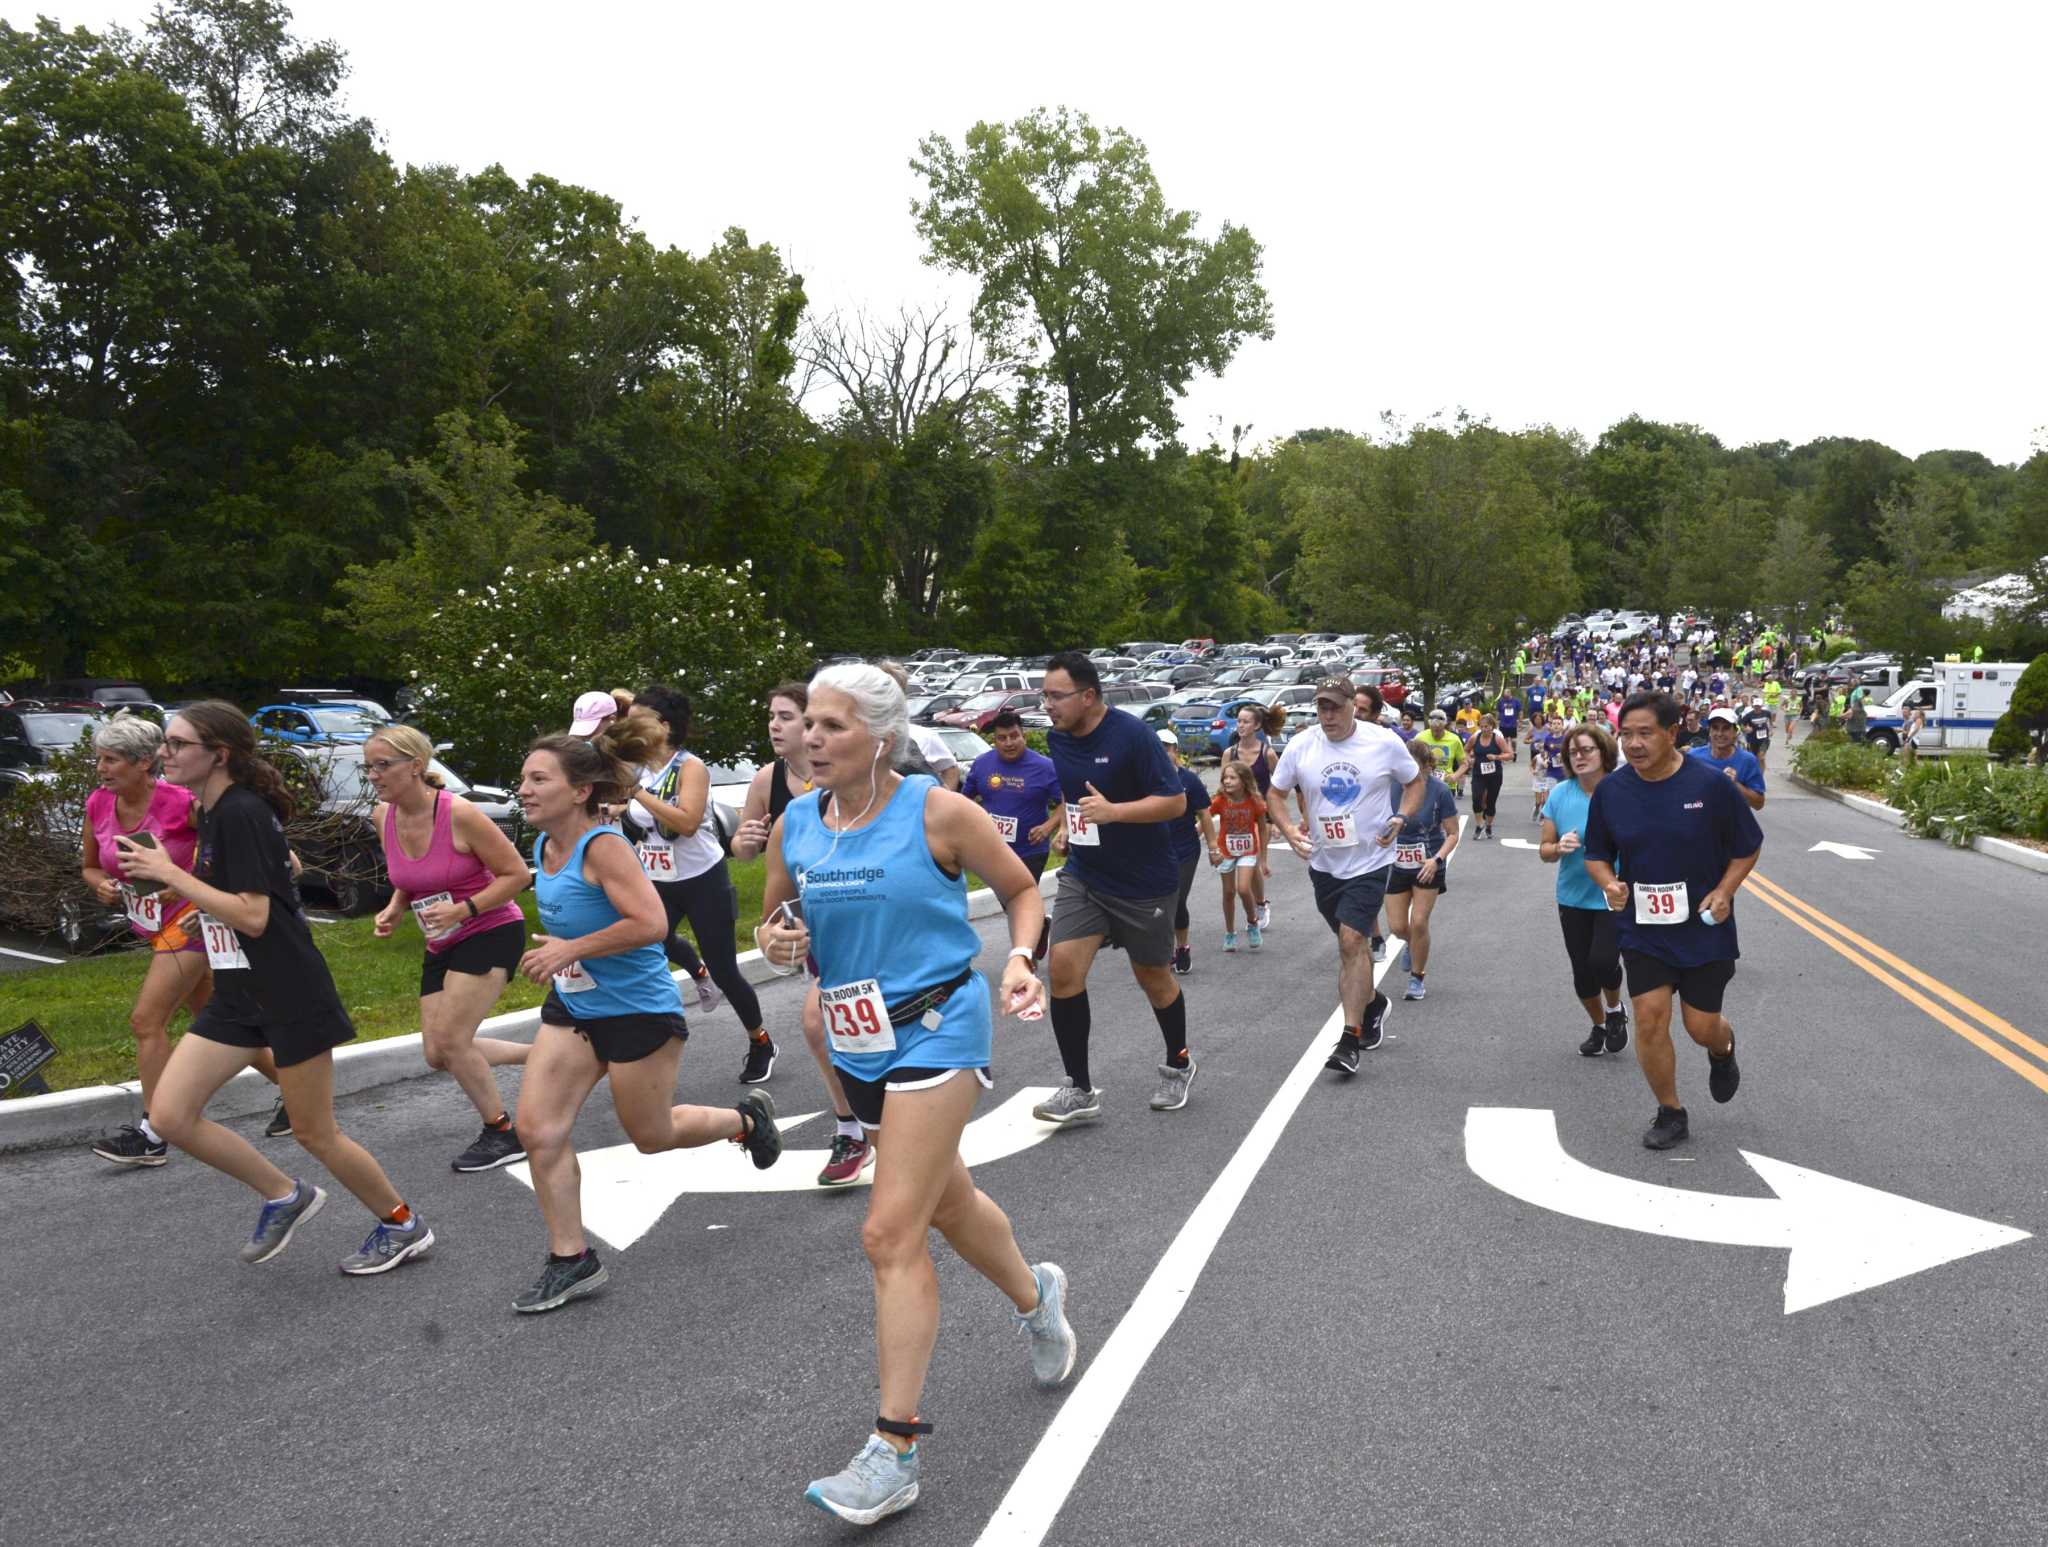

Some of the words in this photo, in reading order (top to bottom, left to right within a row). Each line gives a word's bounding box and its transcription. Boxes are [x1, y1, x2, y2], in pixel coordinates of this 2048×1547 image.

[995, 821, 1013, 836] 82
[1070, 815, 1087, 834] 54
[1324, 822, 1345, 839] 56
[1230, 839, 1250, 851] 160
[1396, 849, 1422, 863] 256
[806, 867, 886, 883] Southridge
[1658, 885, 1674, 893] ROOM
[1647, 894, 1675, 914] 39
[833, 985, 860, 1001] ROOM
[861, 982, 875, 994] 5K
[824, 998, 881, 1037] 239
